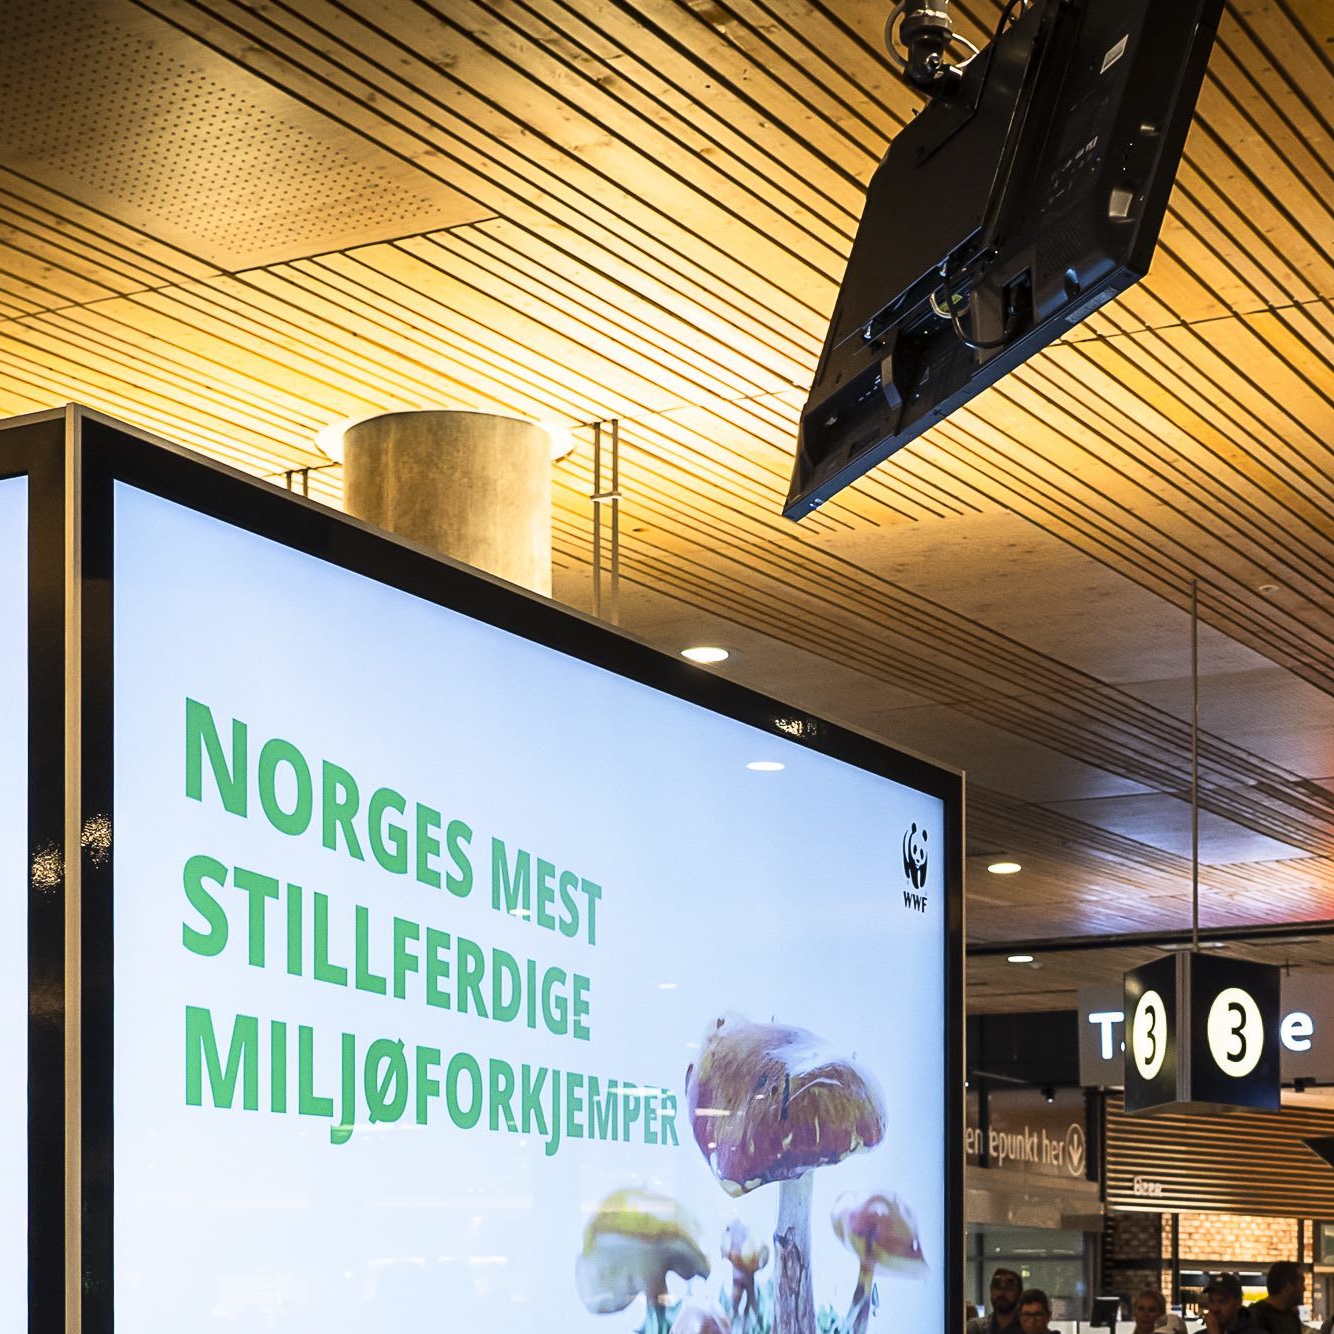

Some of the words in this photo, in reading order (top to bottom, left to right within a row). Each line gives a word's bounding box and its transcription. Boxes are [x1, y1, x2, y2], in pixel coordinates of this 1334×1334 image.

[185, 696, 474, 899] NORGES
[491, 836, 603, 946] MEST
[903, 890, 928, 913] WWF
[182, 853, 591, 1042] STILLFERDIGE
[1144, 1004, 1157, 1066] 3
[1226, 1002, 1247, 1063] 3
[185, 1004, 680, 1157] MILJØFORKJEMPER
[1042, 1128, 1064, 1166] her
